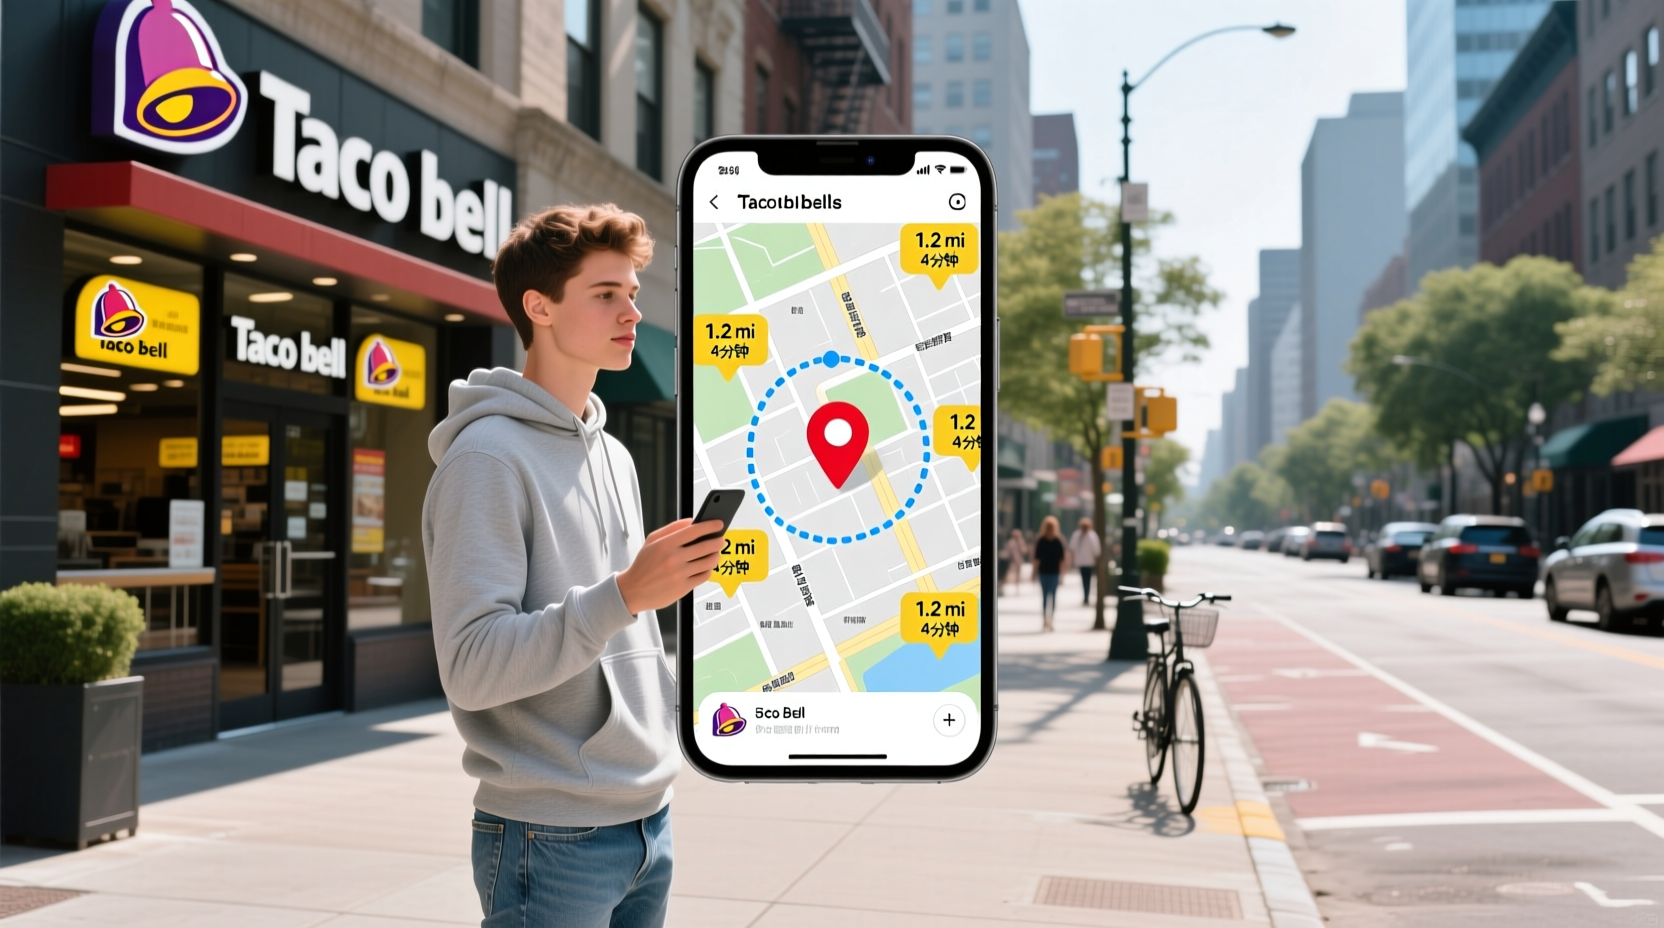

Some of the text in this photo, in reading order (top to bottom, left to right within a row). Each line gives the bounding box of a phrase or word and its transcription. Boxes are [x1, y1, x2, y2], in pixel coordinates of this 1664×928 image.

[260, 69, 512, 260] Taco bell
[915, 231, 965, 248] 1.2 mi
[705, 323, 755, 340] 1.2 mi
[138, 340, 167, 358] bell
[231, 315, 298, 370] Taco
[300, 331, 346, 379] bell
[950, 413, 976, 430] 1.2
[735, 538, 755, 555] mi
[916, 600, 965, 617] 1.2 mi
